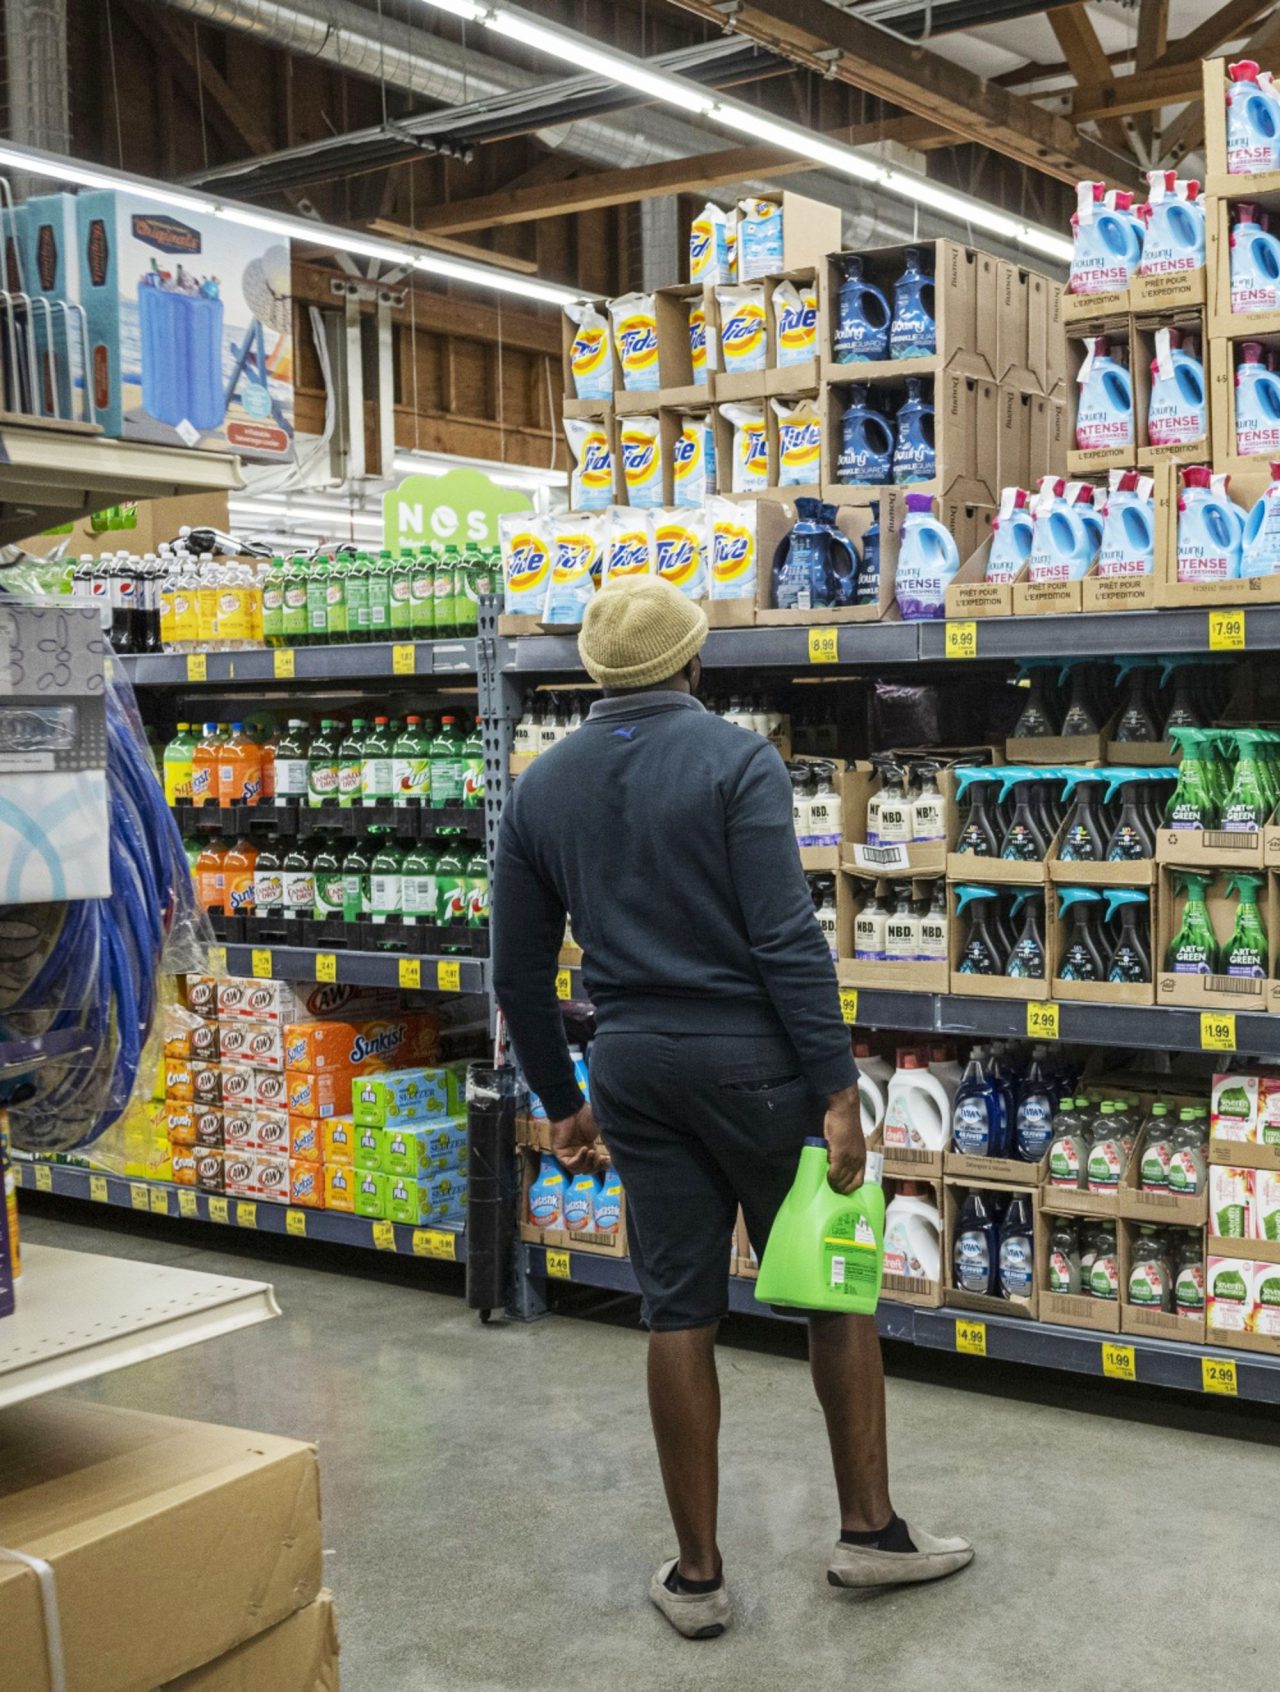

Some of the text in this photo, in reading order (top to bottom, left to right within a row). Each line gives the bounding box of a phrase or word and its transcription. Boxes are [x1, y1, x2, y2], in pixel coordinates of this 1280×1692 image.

[1166, 276, 1187, 285] POUR
[722, 318, 763, 342] Tide
[656, 542, 694, 571] Tide
[509, 549, 545, 578] Tide
[1047, 582, 1067, 590] POUR
[1120, 580, 1141, 588] POUR
[981, 588, 999, 597] POUR
[1175, 804, 1191, 812] ART
[1230, 804, 1246, 812] ART
[882, 811, 904, 823] NBD.
[1172, 812, 1200, 820] GREEN
[1227, 812, 1255, 820] GREEN
[857, 921, 876, 933] NBD.
[888, 925, 914, 938] NBD.
[922, 926, 944, 938] NBD.
[1176, 953, 1206, 961] GREEN
[1229, 956, 1261, 965] GREEN
[1204, 1024, 1230, 1039] $1.99
[350, 1023, 407, 1063] Sunkist
[1206, 1366, 1234, 1382] $2.99
